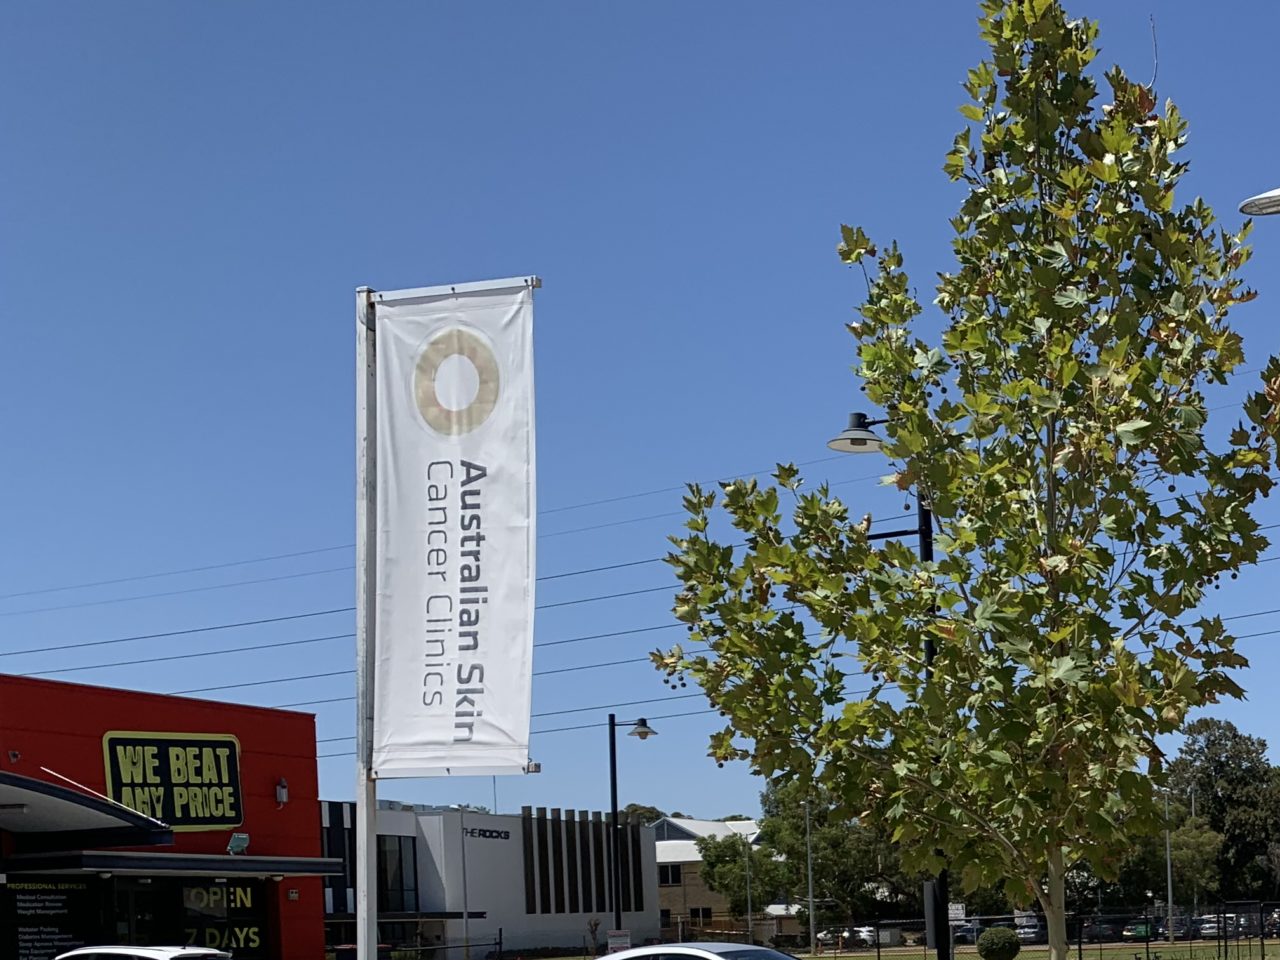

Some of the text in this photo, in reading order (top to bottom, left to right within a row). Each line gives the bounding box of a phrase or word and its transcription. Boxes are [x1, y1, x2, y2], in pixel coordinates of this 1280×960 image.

[422, 460, 454, 706] Cancer Clinics
[453, 459, 489, 743] Australian Skin
[116, 745, 230, 784] WE BEAT
[121, 786, 236, 818] ANY PRICE
[190, 887, 252, 908] OPEN
[184, 927, 261, 948] 7 DAYS
